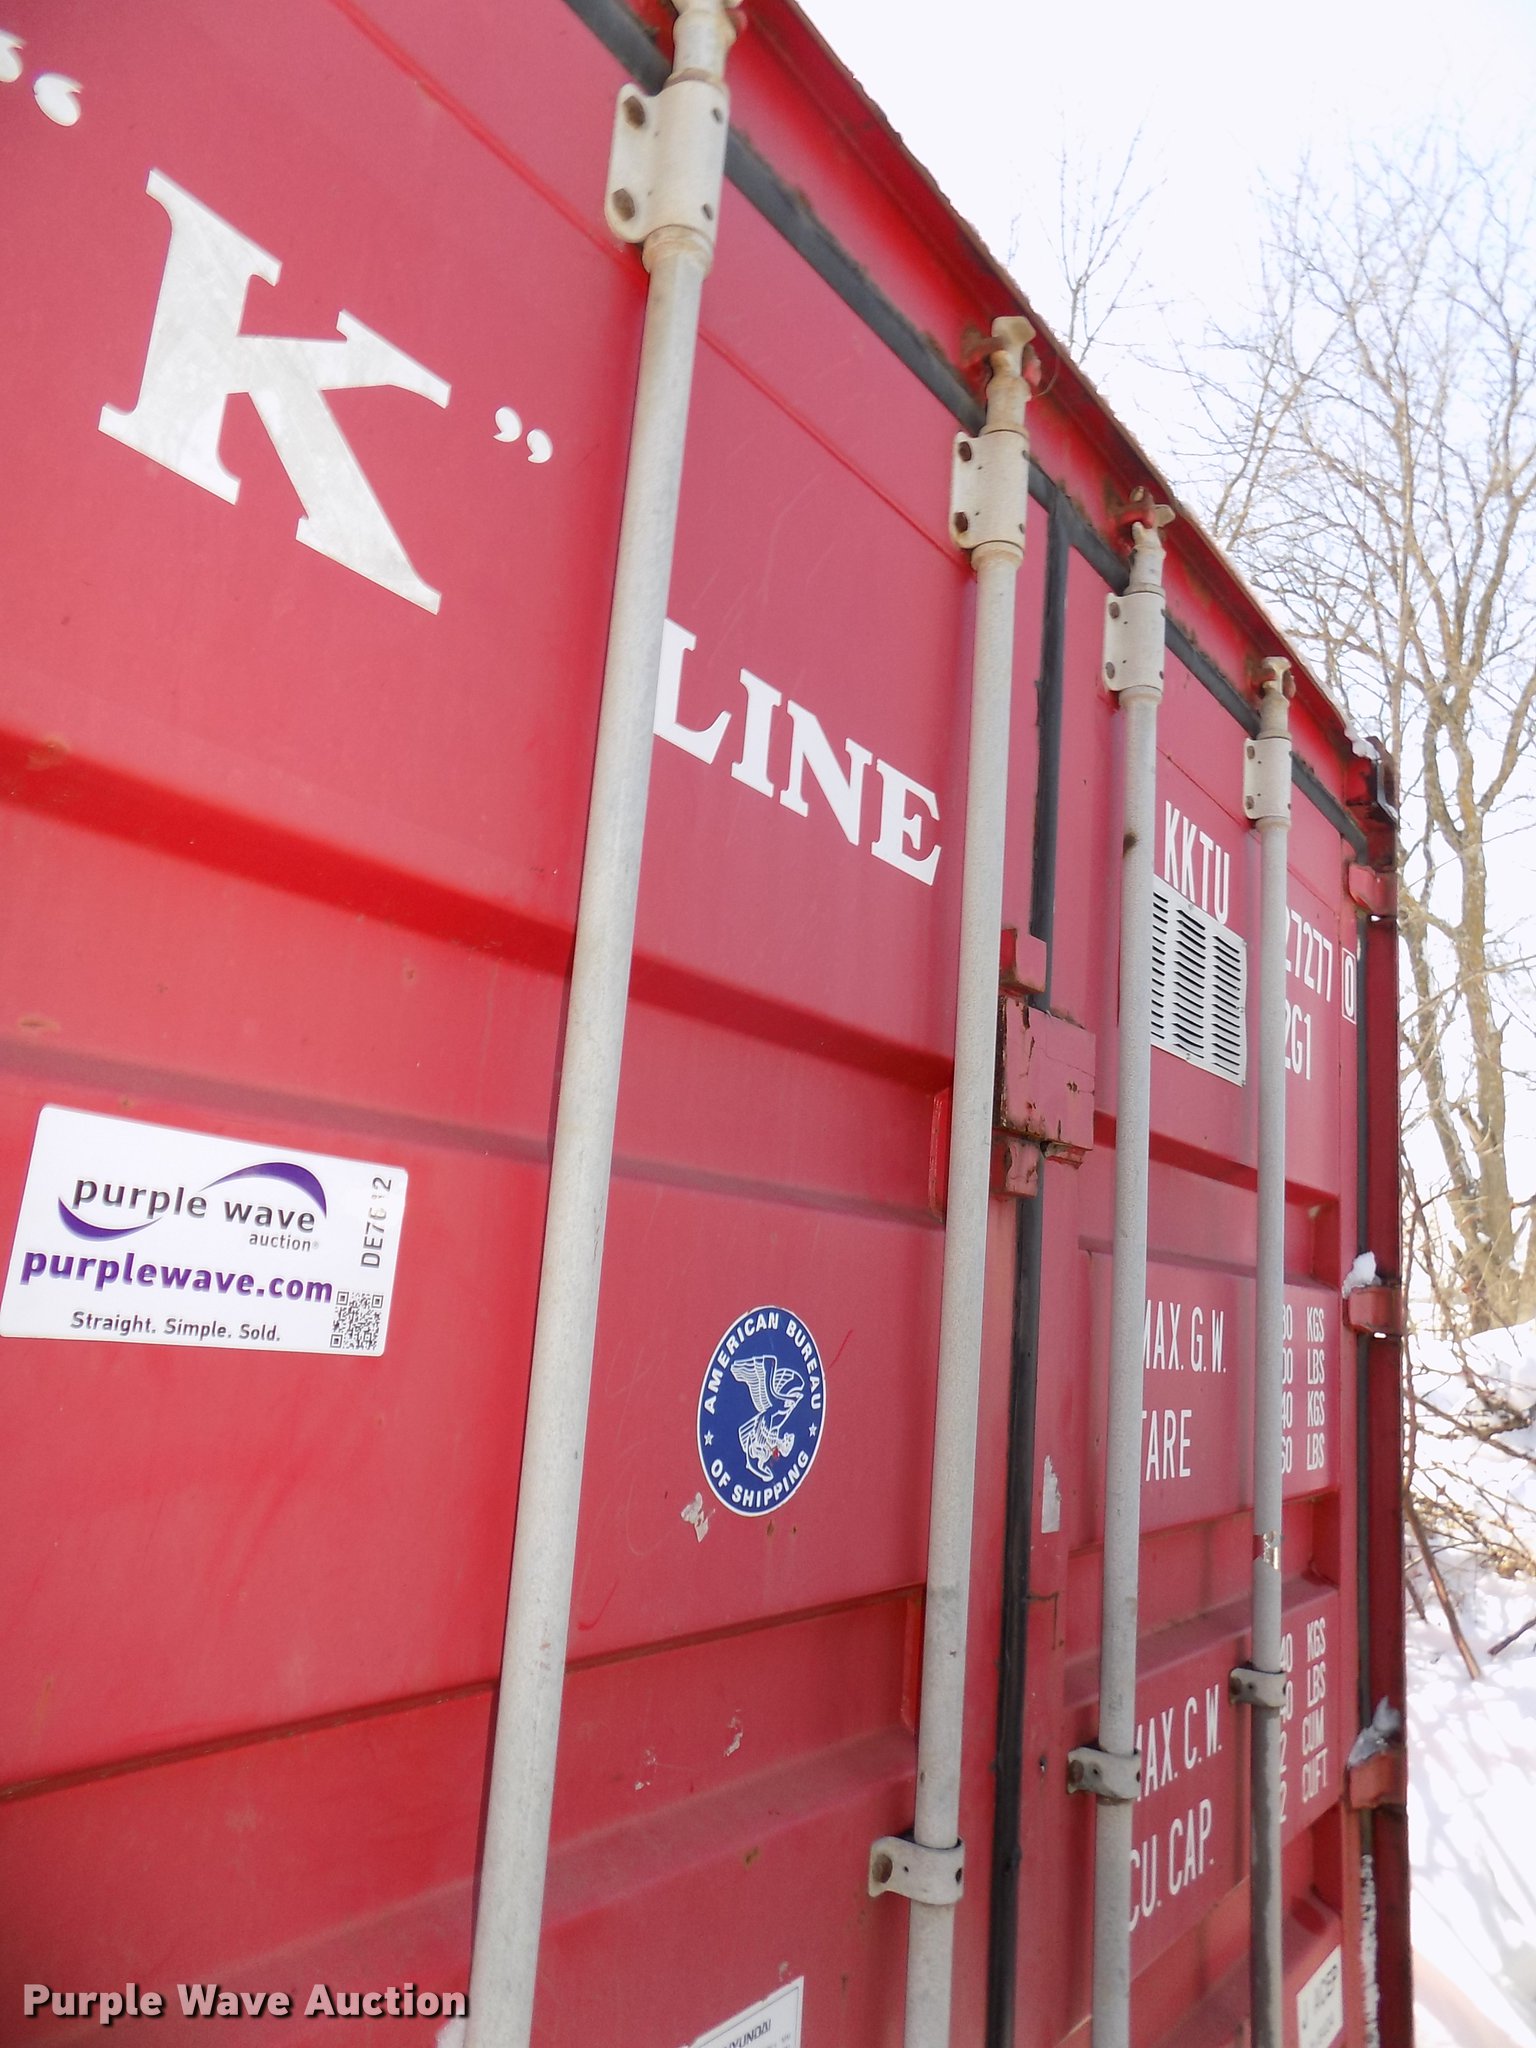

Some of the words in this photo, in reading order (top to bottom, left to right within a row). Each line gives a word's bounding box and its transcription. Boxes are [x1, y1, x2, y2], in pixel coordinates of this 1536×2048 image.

[653, 617, 942, 886] LINE
[1164, 800, 1230, 925] KKTU
[71, 1178, 208, 1219] purple
[224, 1200, 316, 1234] wave
[360, 1177, 392, 1269] DE762
[19, 1249, 333, 1304] purplewave.com
[70, 1310, 157, 1337] Straight.
[163, 1317, 232, 1342] Simple.
[239, 1323, 281, 1343] Sold.
[1307, 1306, 1325, 1343] KGS
[704, 1311, 779, 1416] AMERICAN
[786, 1319, 821, 1410] BUREAU
[1307, 1348, 1325, 1385] LBS
[1307, 1390, 1325, 1427] KGS
[710, 1458, 732, 1489] OF
[732, 1450, 810, 1508] SHIPPING
[1306, 1432, 1325, 1471] LBS
[1307, 1617, 1326, 1662] KGS
[1307, 1661, 1326, 1708] LBS
[1168, 1798, 1215, 1896] CAP.
